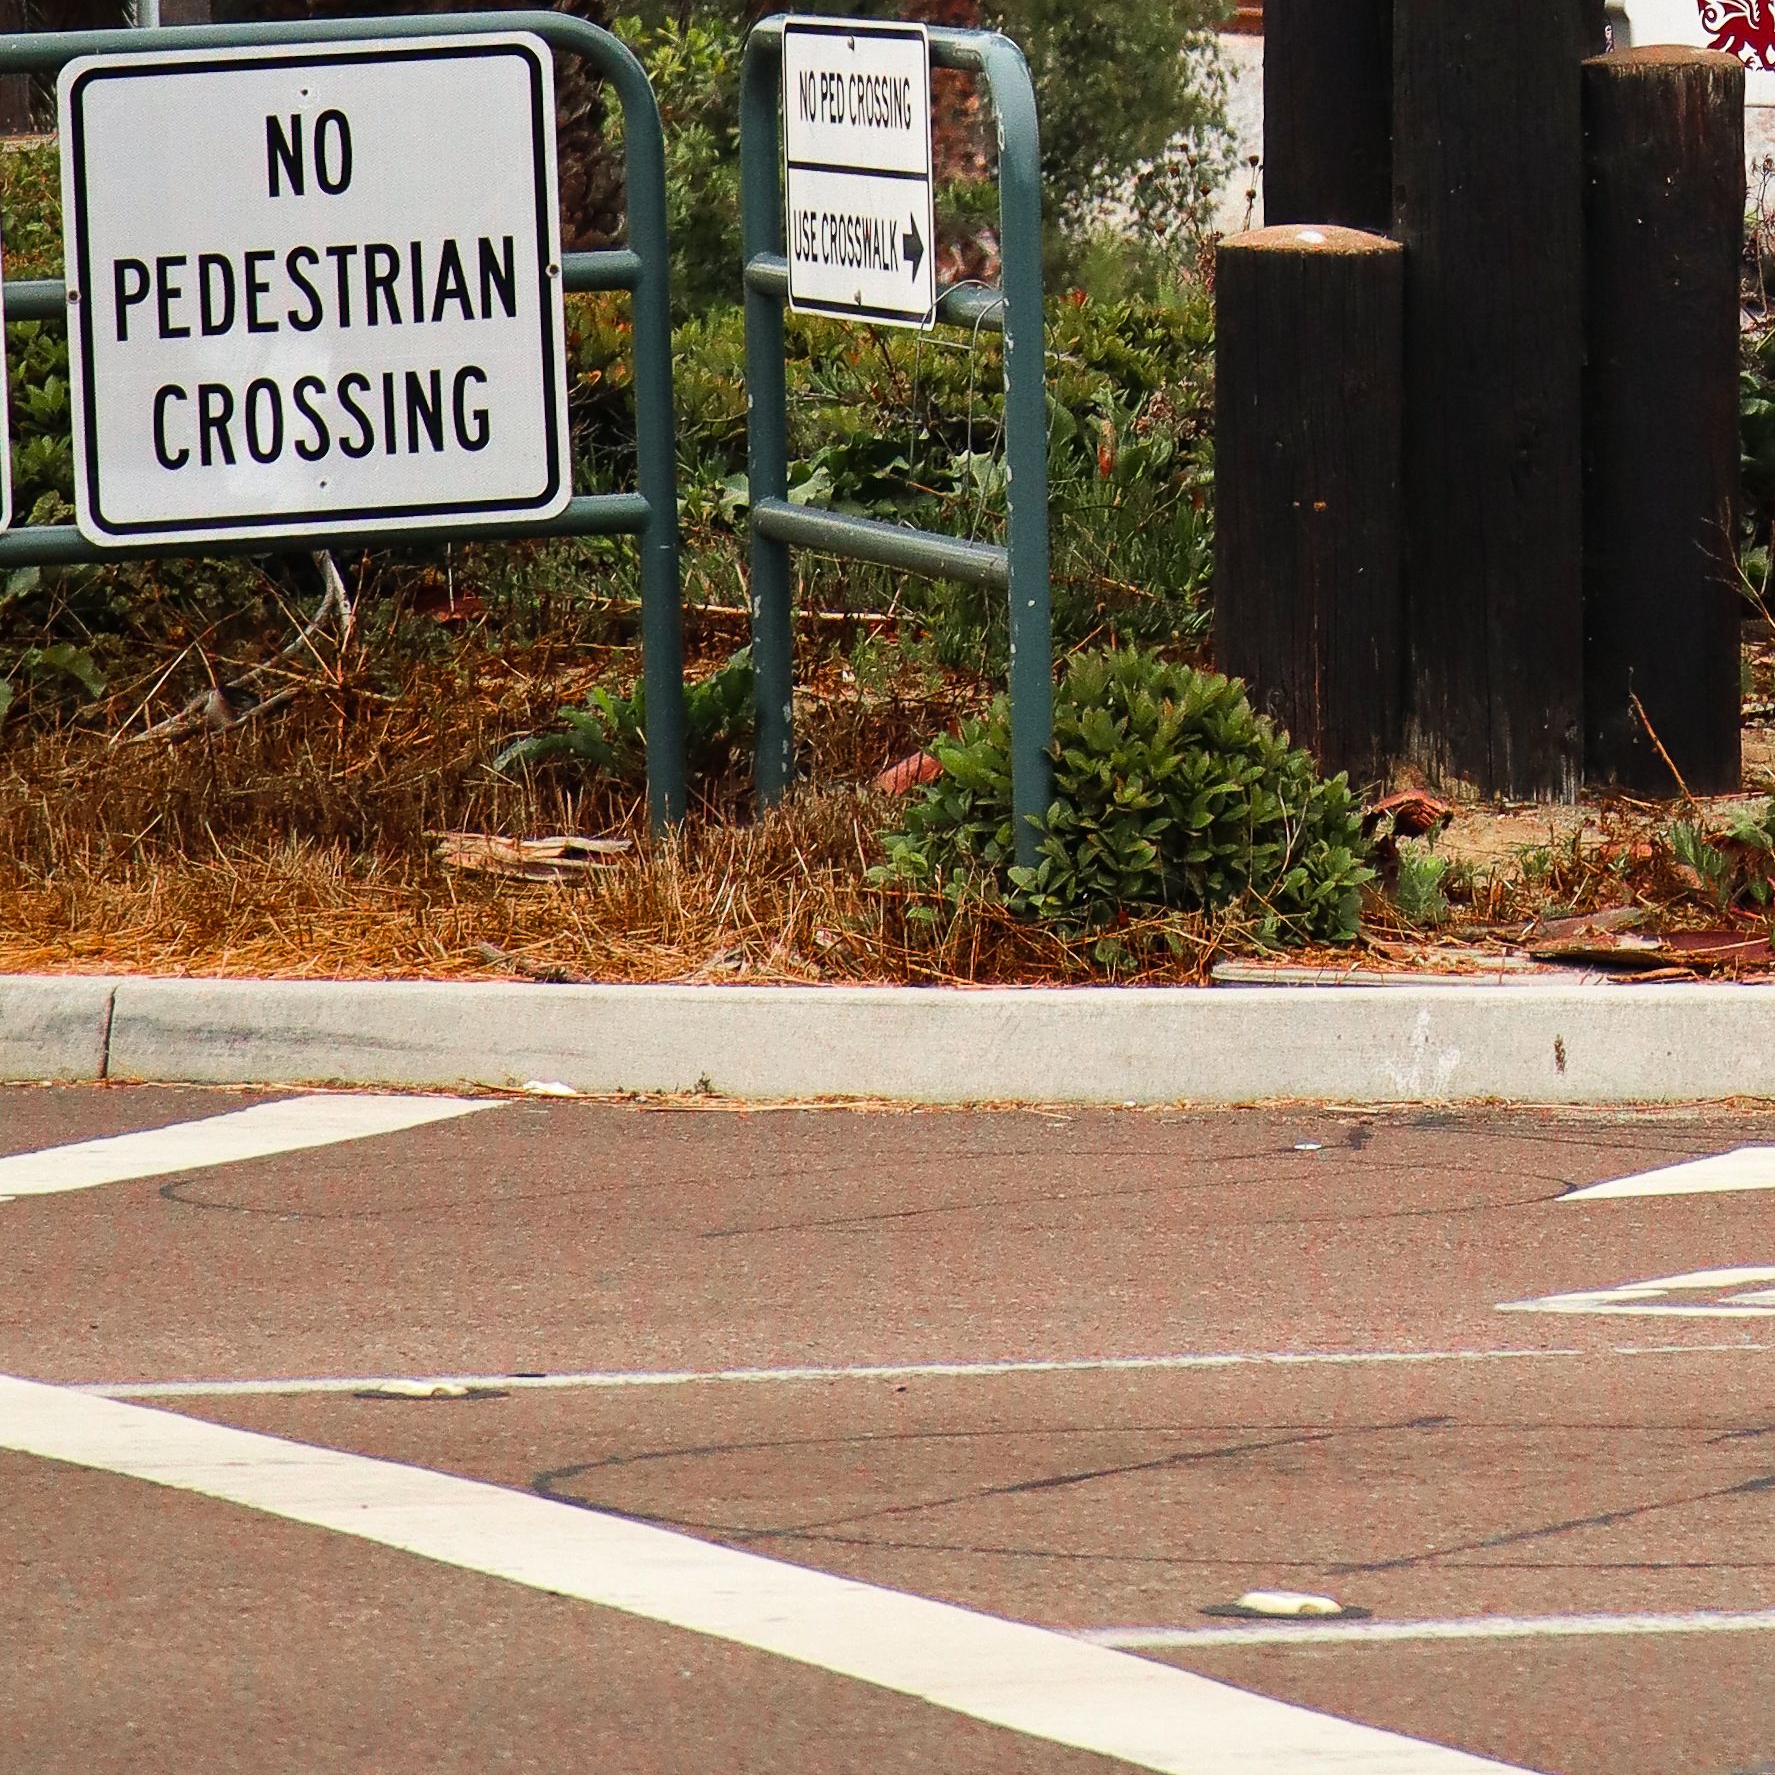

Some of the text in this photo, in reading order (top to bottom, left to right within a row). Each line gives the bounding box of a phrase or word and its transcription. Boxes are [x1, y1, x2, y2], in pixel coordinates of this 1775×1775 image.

[799, 70, 911, 130] NO PED CROSSING
[266, 109, 353, 198] NO
[793, 210, 898, 272] USE CROSSWALK
[114, 236, 517, 342] PEDESTRIAN
[154, 365, 490, 470] CROSSING
